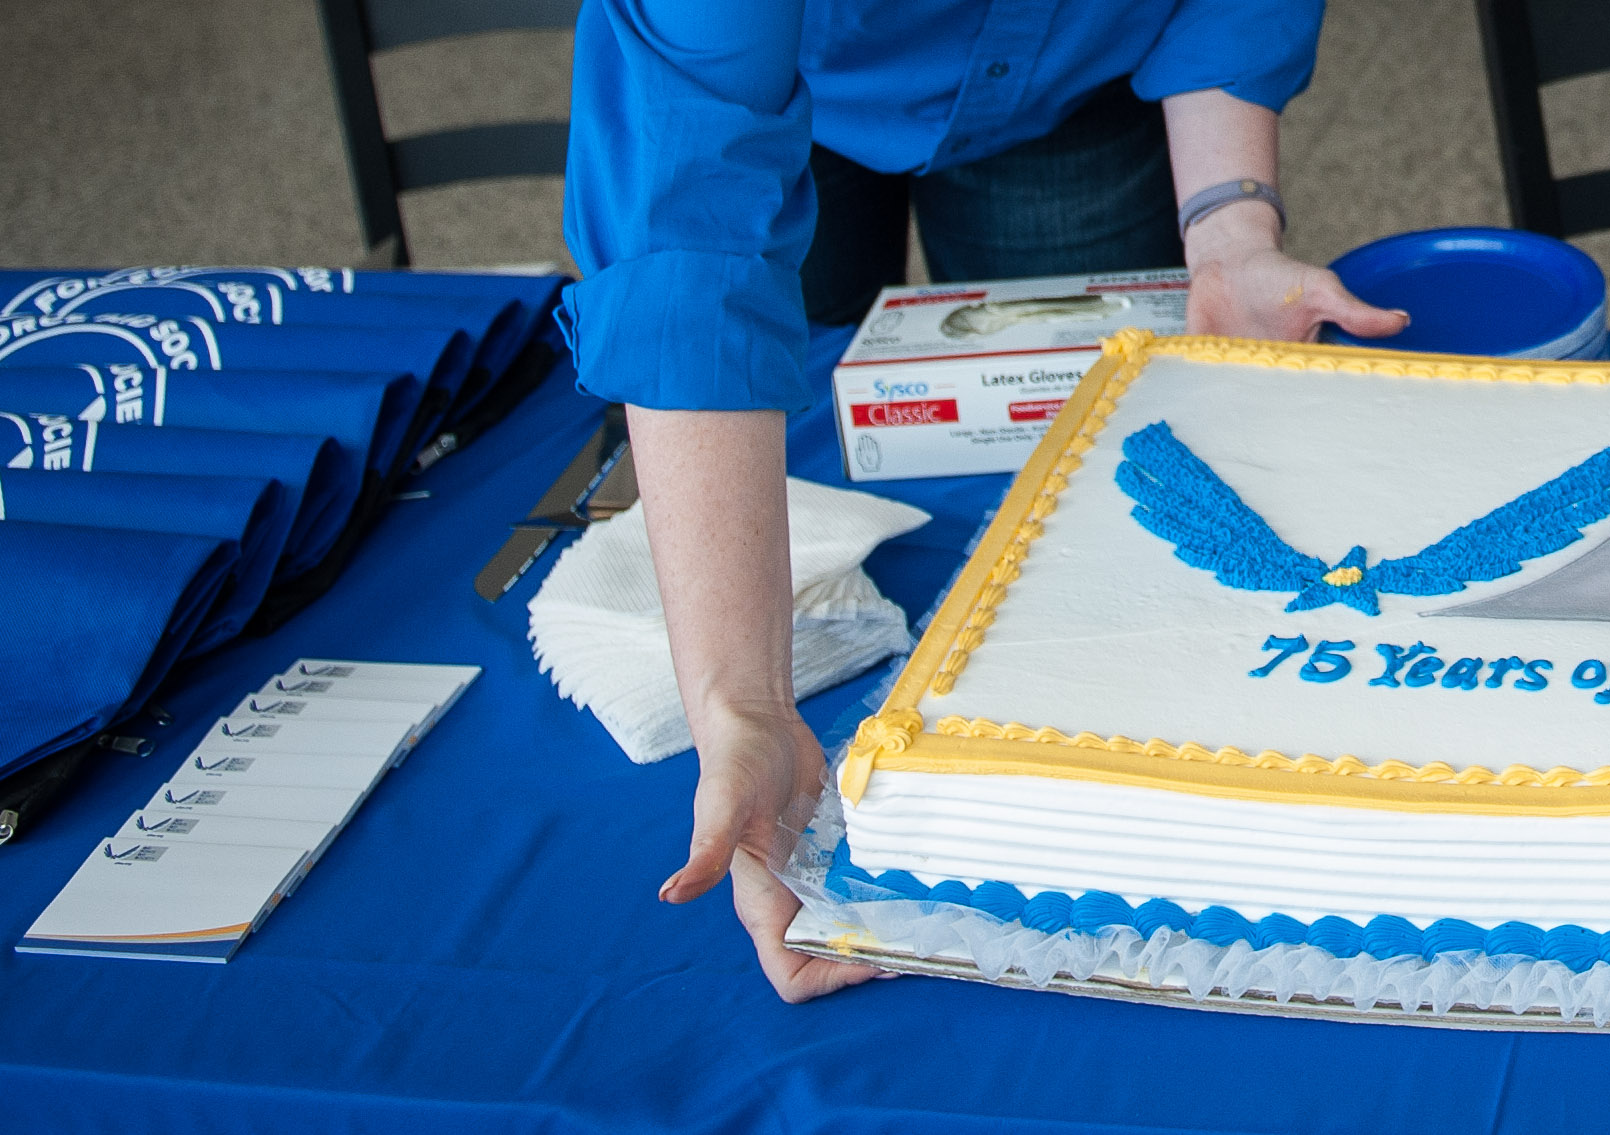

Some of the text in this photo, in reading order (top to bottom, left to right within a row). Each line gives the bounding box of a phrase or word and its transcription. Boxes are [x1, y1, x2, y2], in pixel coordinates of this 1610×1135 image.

[981, 369, 1083, 387] Latex Gloves
[873, 379, 929, 401] Sysco
[868, 401, 941, 426] Classic
[1248, 633, 1356, 684] 75
[1368, 640, 1554, 691] Years
